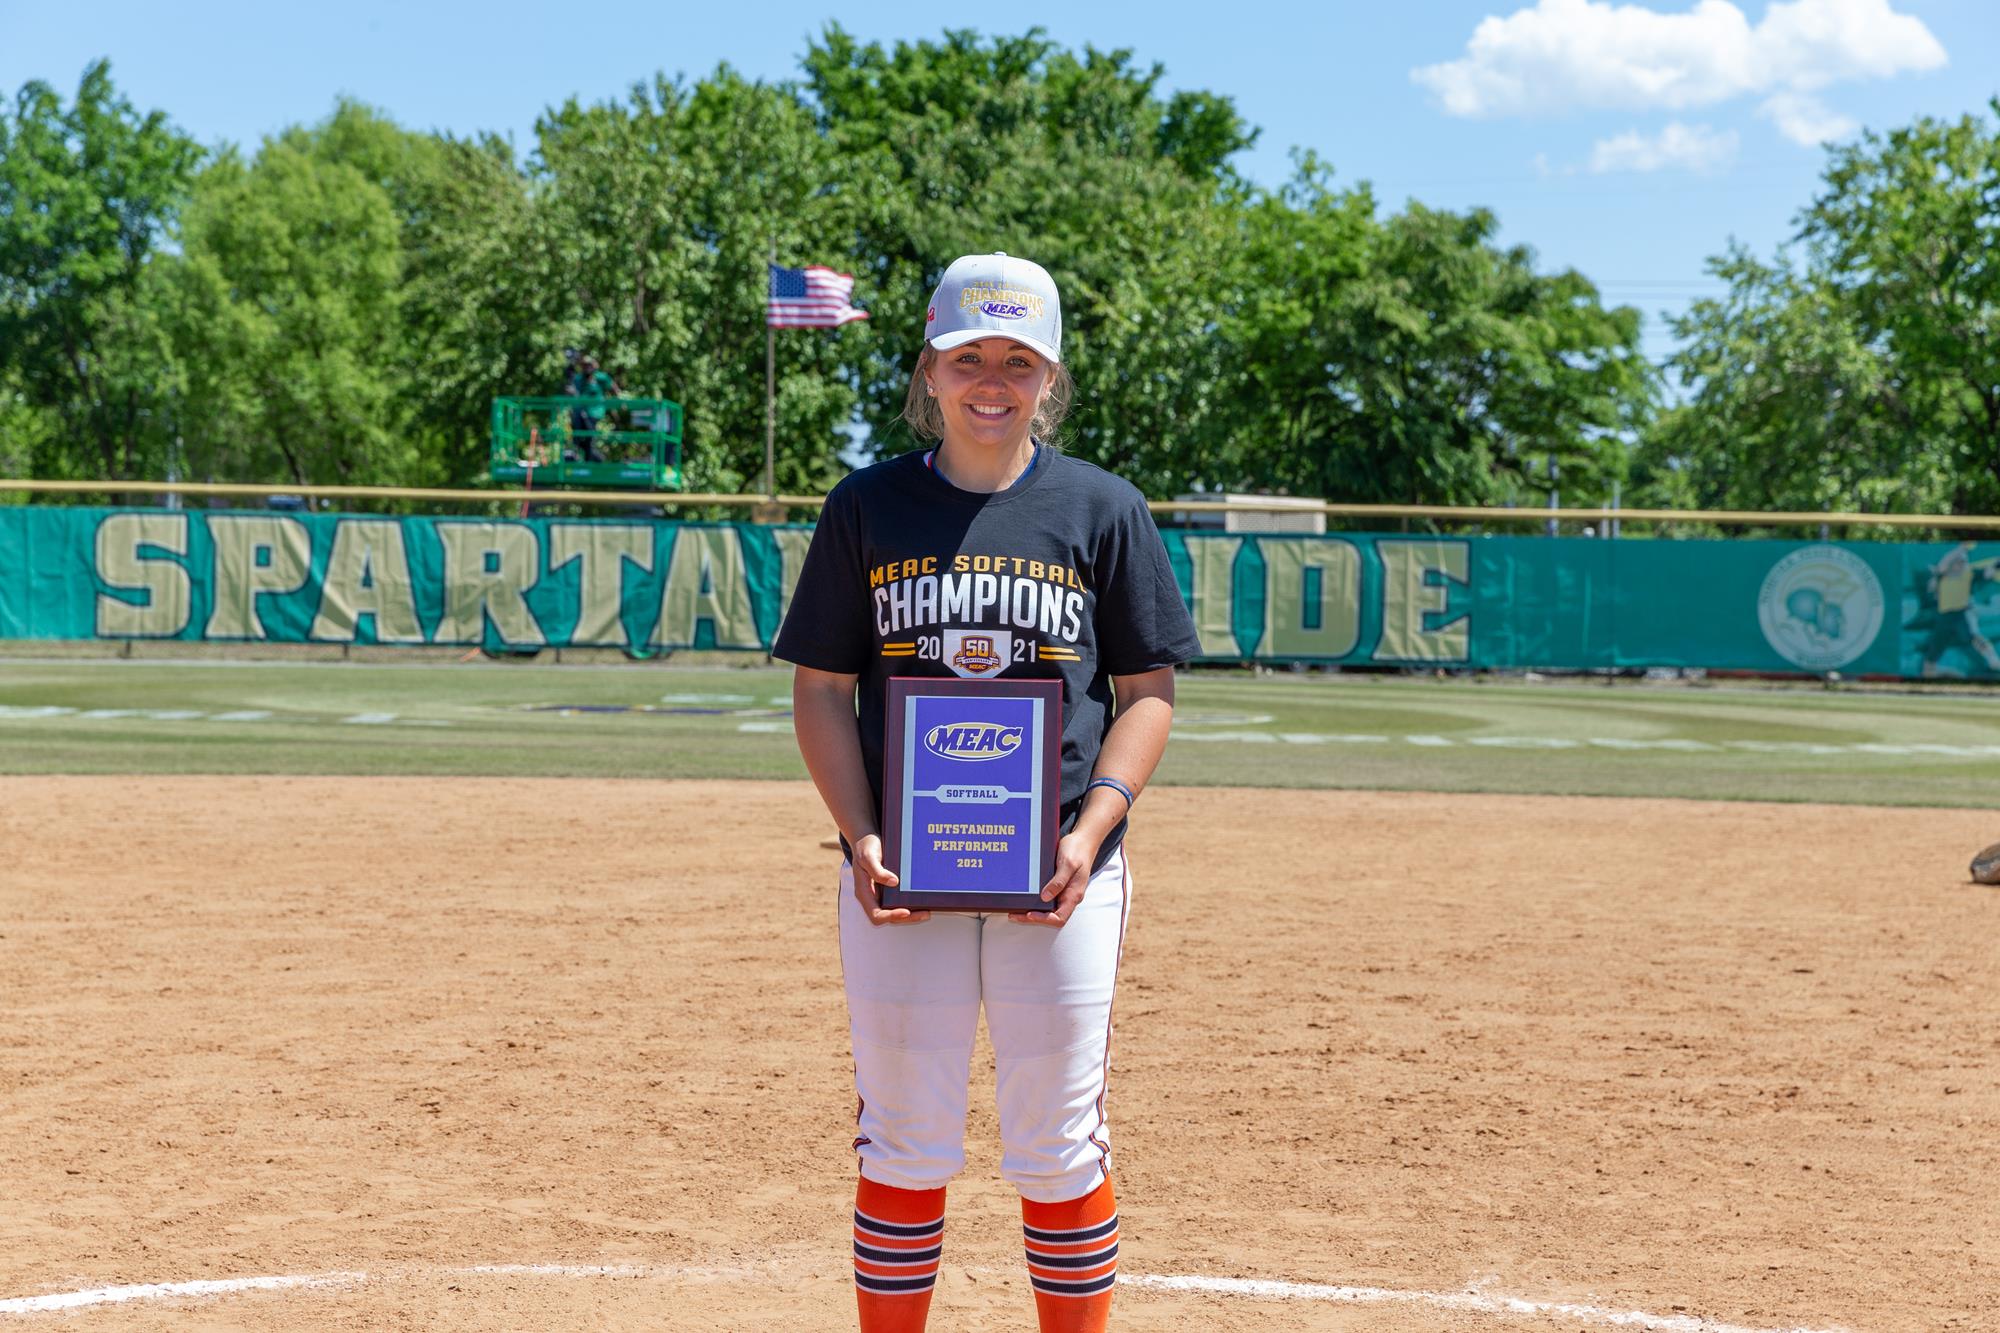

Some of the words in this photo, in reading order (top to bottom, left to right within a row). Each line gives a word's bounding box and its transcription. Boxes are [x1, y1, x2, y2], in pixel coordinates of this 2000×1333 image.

[986, 303, 1026, 316] MEAC
[870, 556, 938, 588] MEAC
[954, 554, 1088, 594] SOFTBALL
[874, 573, 1085, 643] CHAMPIONS
[917, 635, 941, 660] 20
[1013, 638, 1036, 662] 21
[965, 639, 989, 657] 50
[935, 725, 1024, 754] MEAC
[946, 789, 999, 799] SOFTBALL
[927, 823, 1016, 835] OUTSTANDING
[933, 840, 1009, 852] PERFORMER
[956, 858, 984, 868] 2021
